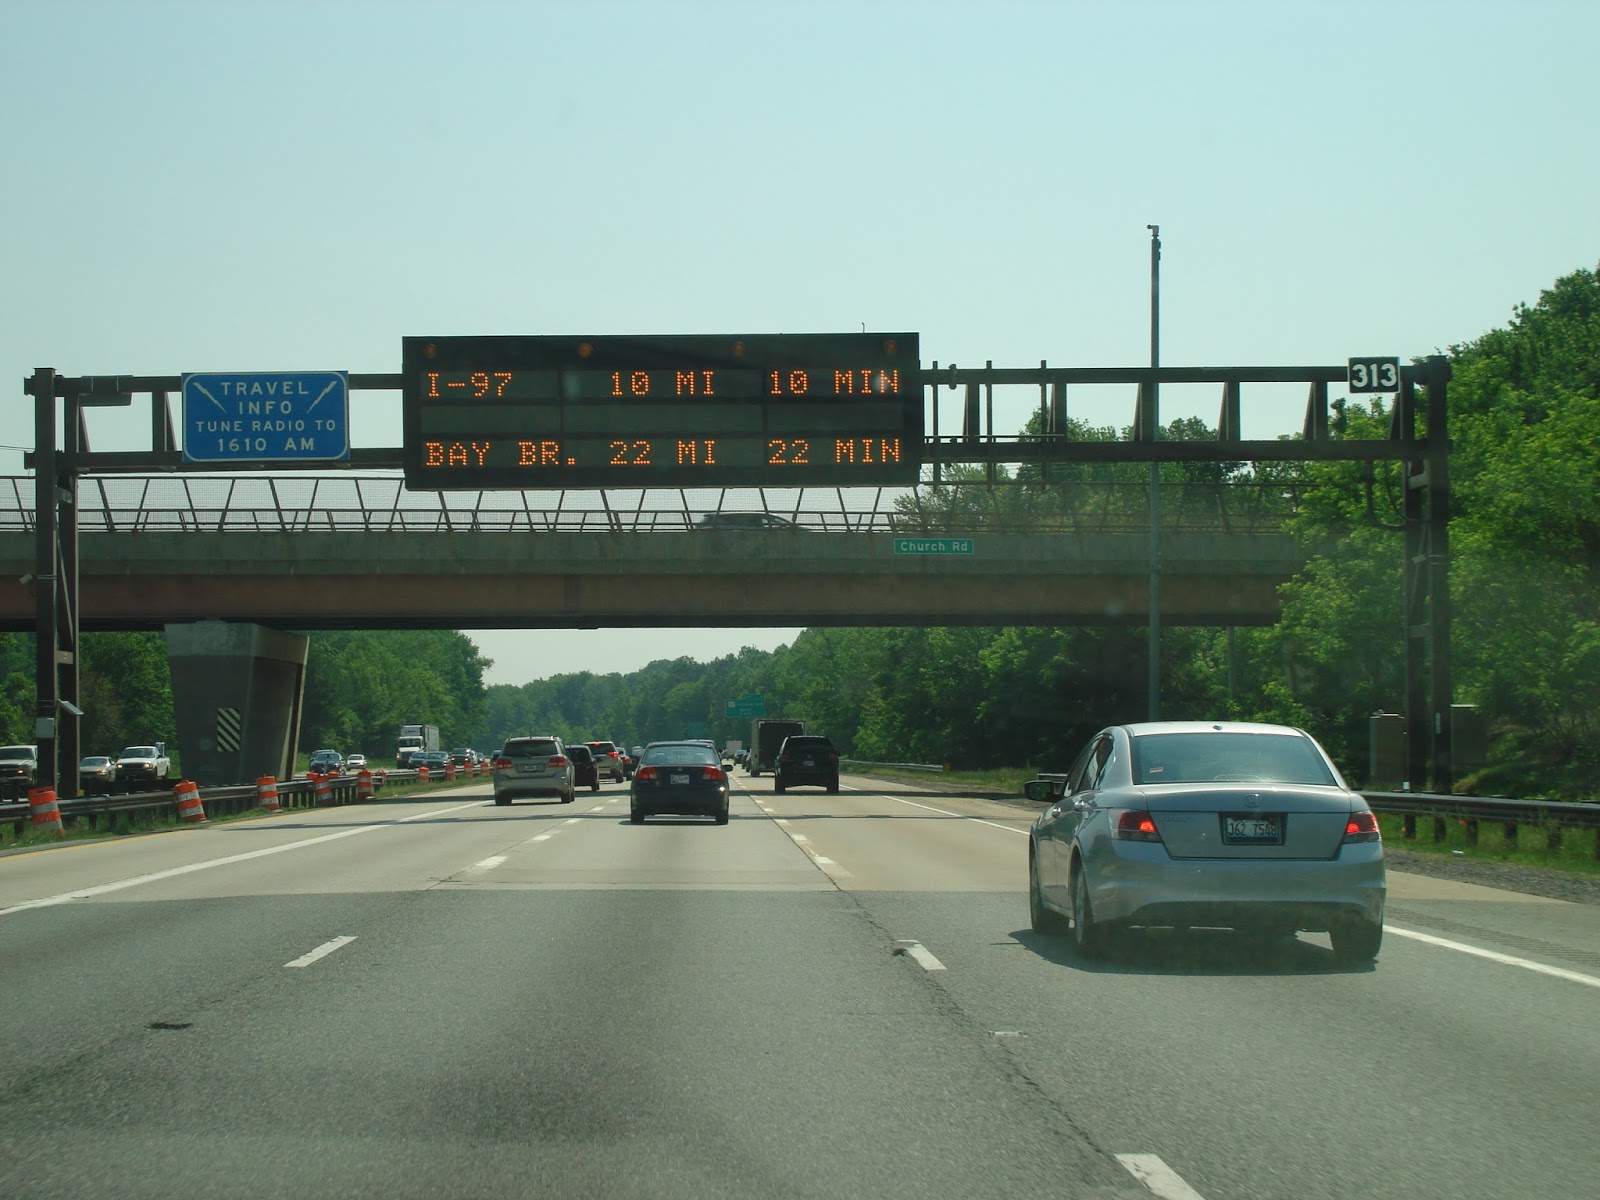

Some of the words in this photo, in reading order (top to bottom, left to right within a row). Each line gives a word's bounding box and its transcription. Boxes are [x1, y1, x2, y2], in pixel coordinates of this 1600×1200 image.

[427, 372, 512, 397] I-97
[611, 371, 649, 396] 10
[676, 370, 714, 395] MI
[770, 370, 808, 394] 10
[834, 369, 898, 394] MIN
[1351, 363, 1397, 388] 313
[220, 381, 309, 396] TRAVEL
[239, 400, 292, 415] INFO
[196, 420, 243, 432] TUNE
[252, 419, 305, 432] RADIO
[315, 419, 336, 431] TO
[218, 437, 267, 452] 1610
[284, 437, 314, 451] AM
[425, 442, 490, 466] BAY
[518, 441, 576, 466] BR.
[609, 440, 651, 465] 22
[678, 440, 716, 464] MI
[768, 439, 809, 464] 22
[835, 438, 900, 463] MIN
[900, 541, 945, 551] Church
[952, 541, 968, 551] Rd
